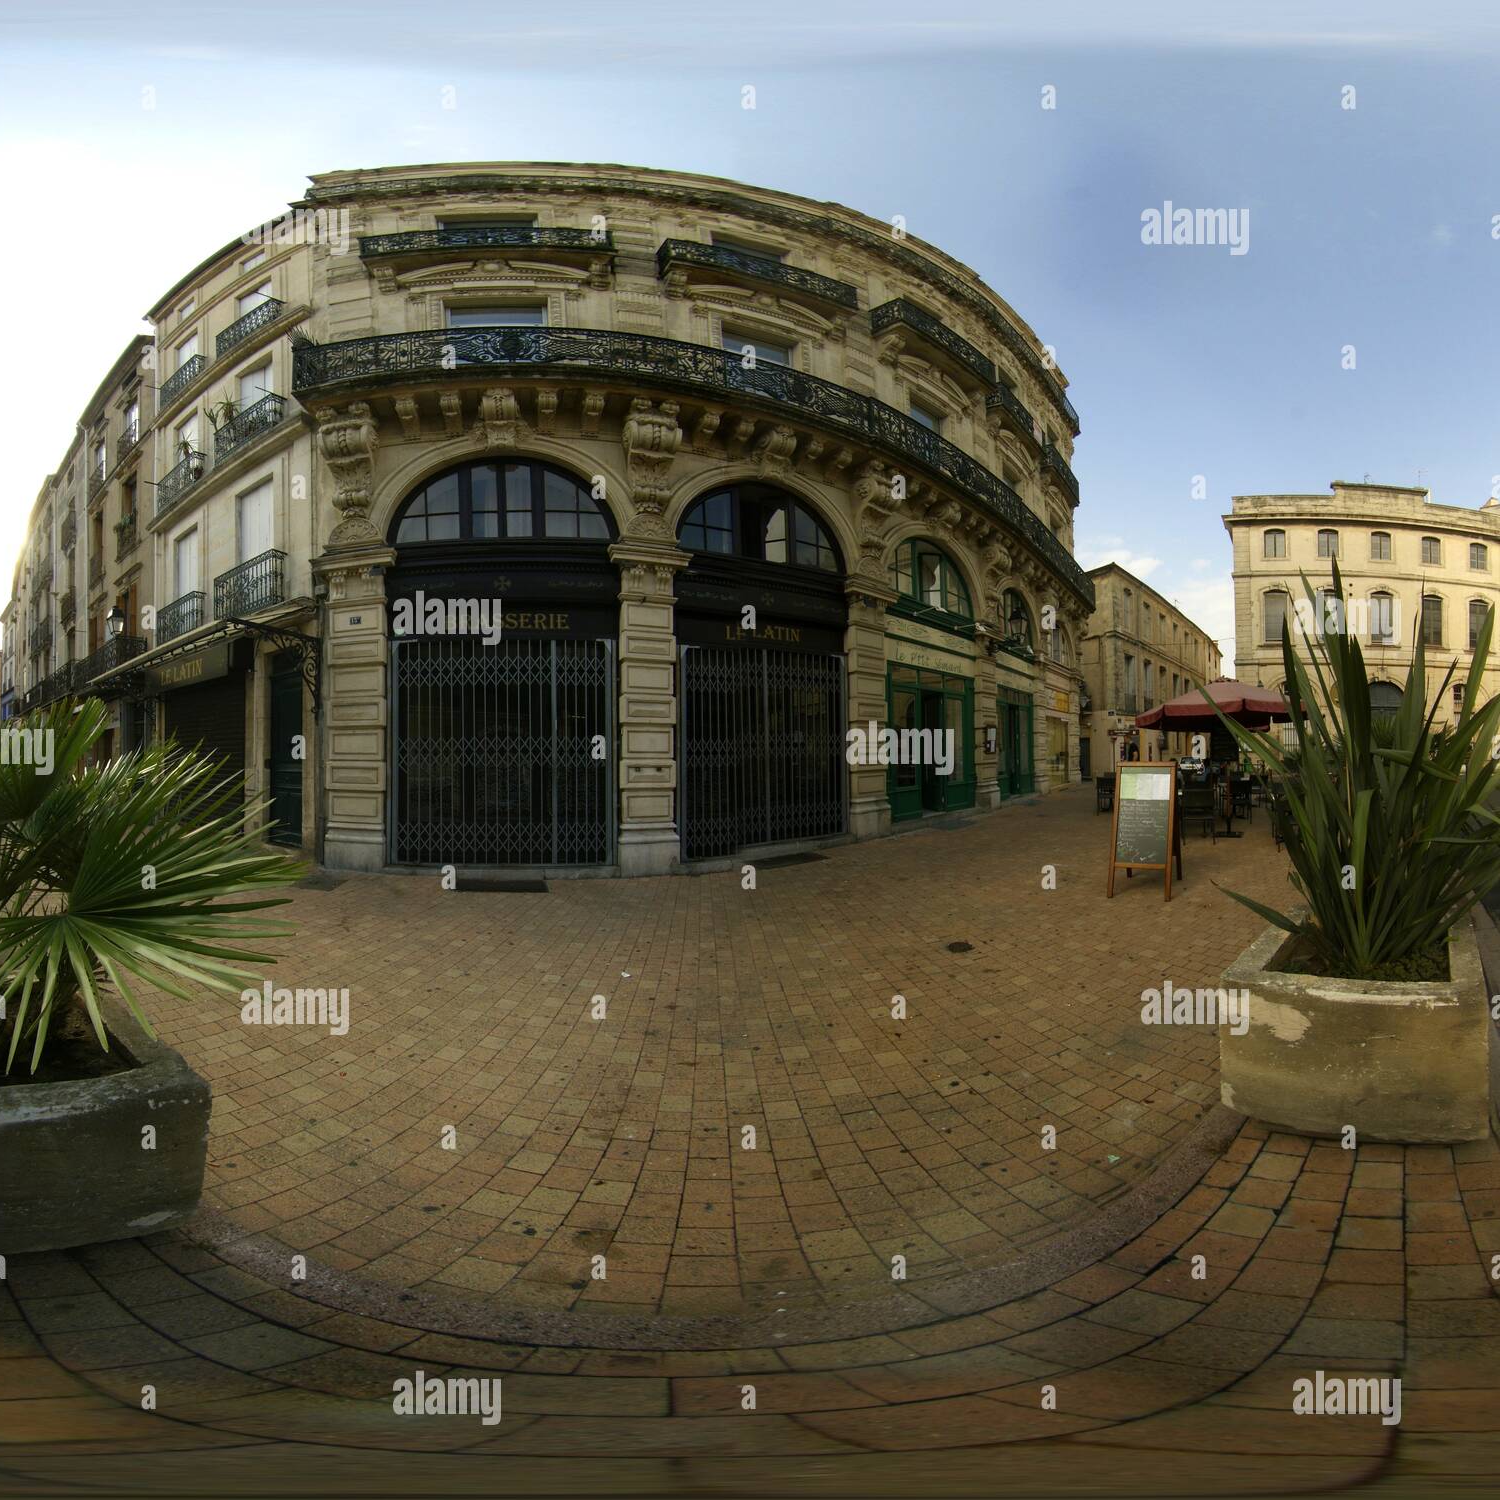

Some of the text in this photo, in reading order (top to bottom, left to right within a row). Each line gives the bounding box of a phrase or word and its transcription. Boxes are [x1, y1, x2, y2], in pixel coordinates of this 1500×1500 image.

[725, 625, 802, 642] LE LATIN
[160, 658, 204, 686] LE LATIN
